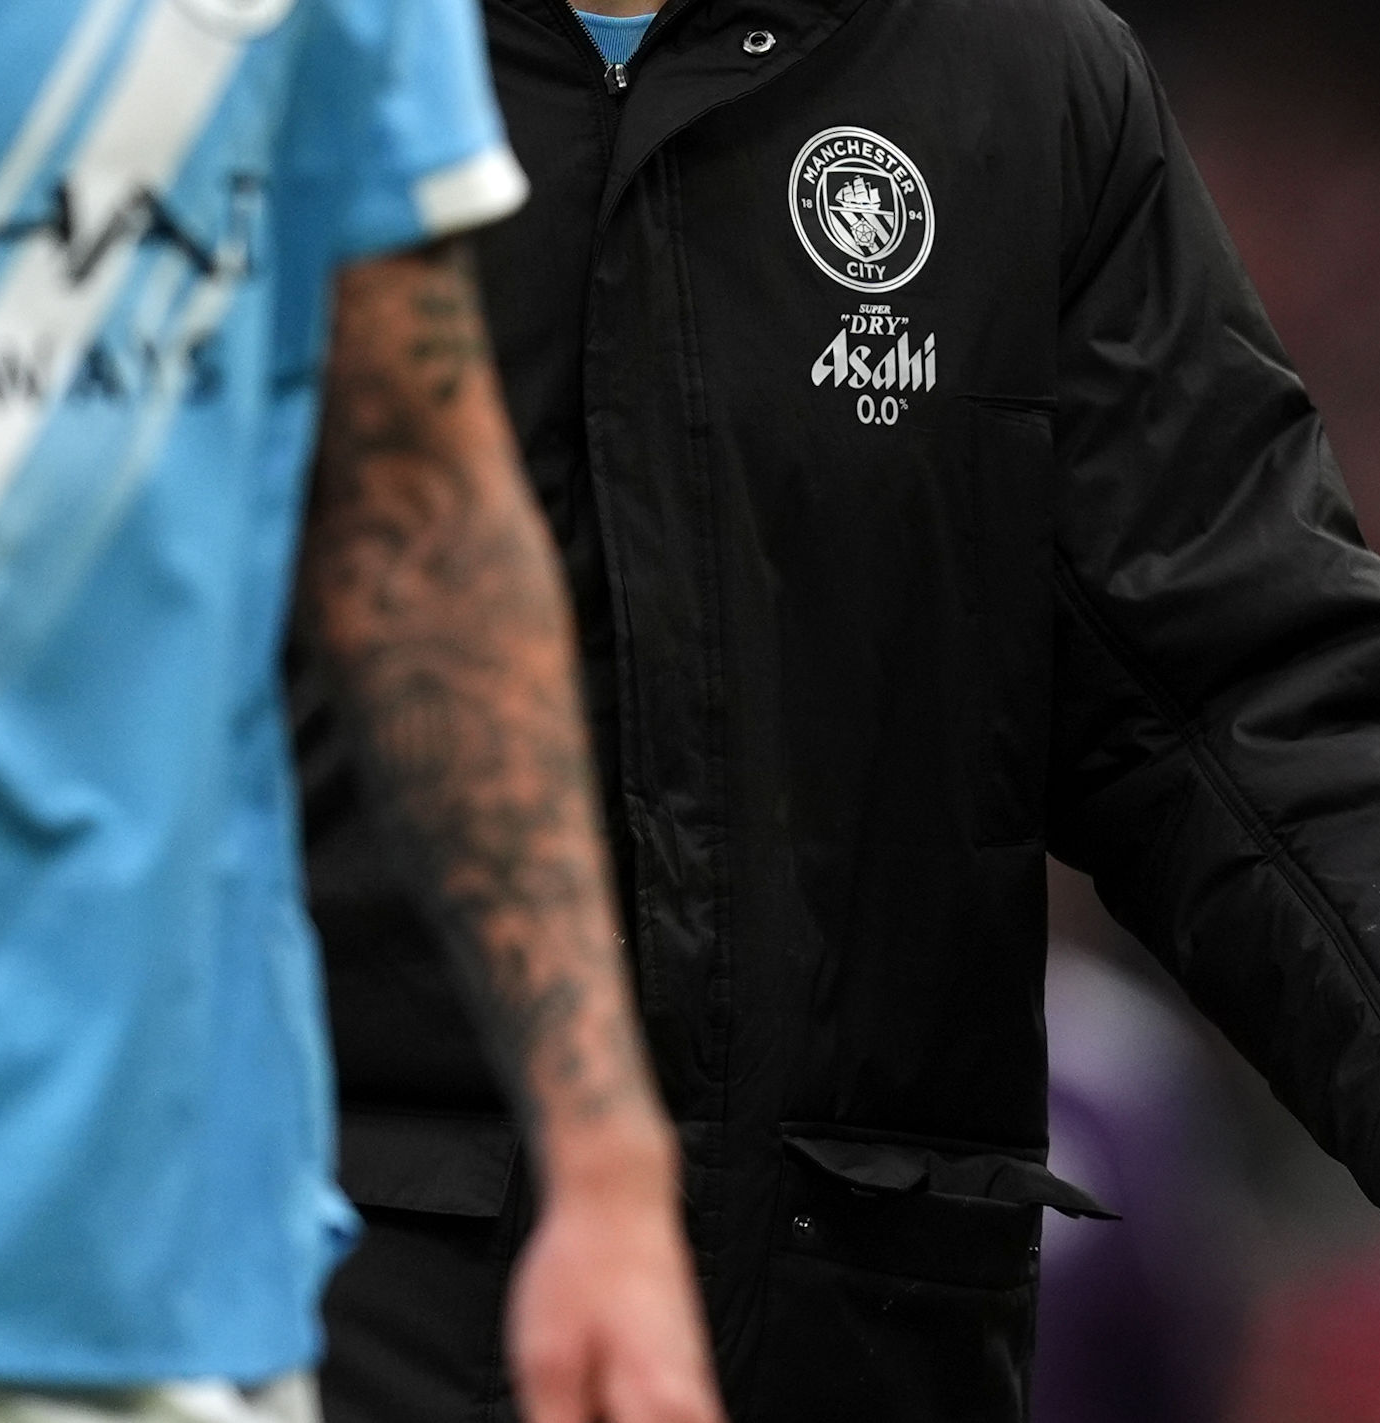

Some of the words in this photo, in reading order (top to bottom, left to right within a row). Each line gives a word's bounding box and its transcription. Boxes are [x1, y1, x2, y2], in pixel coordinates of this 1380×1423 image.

[803, 139, 915, 196] MANCHESTER
[801, 197, 813, 209] 18
[909, 210, 923, 221] 94
[847, 261, 888, 280] CITY
[859, 304, 891, 314] SUPER
[811, 328, 936, 392] Asahi
[856, 394, 909, 426] 0.0%
